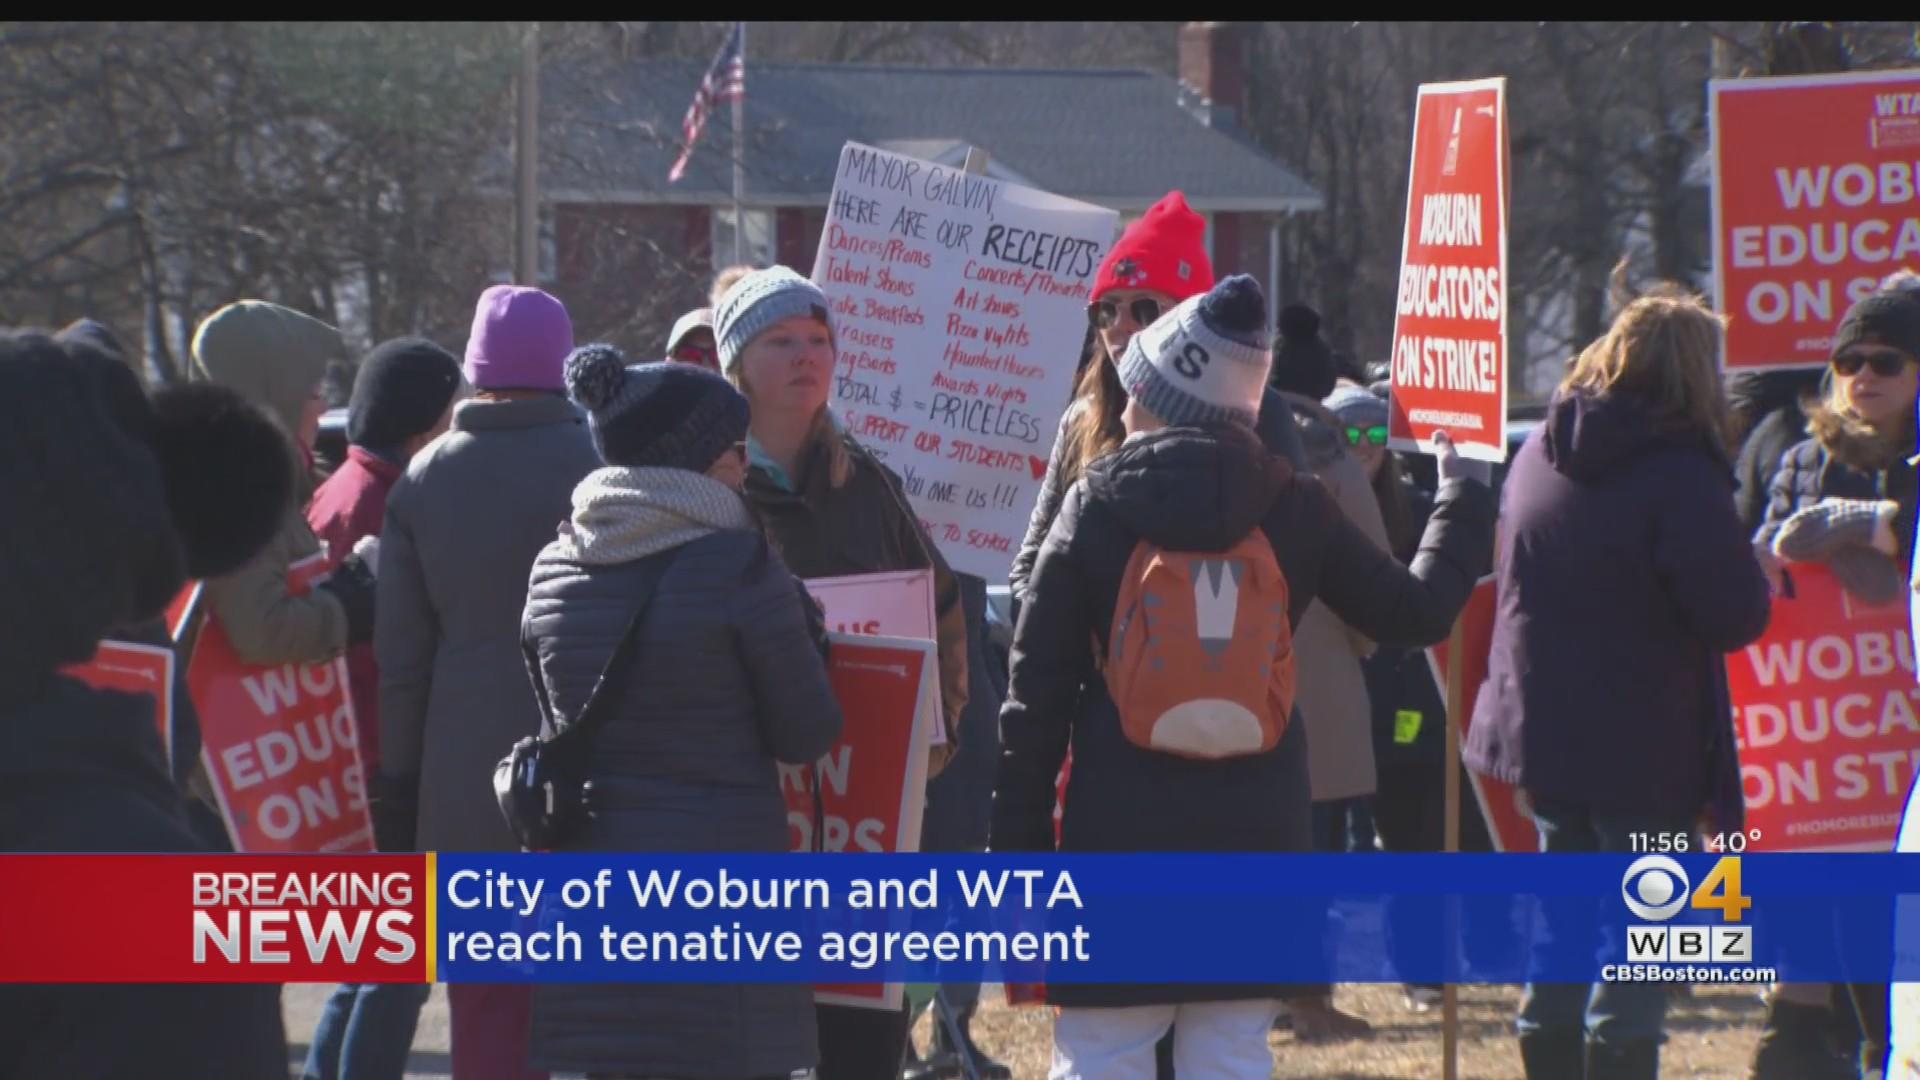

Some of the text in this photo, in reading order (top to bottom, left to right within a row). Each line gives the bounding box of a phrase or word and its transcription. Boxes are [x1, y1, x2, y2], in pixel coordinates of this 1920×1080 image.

[845, 148, 998, 221] MAYOR GALVIN,
[1775, 163, 1920, 209] WOB
[834, 190, 881, 225] HERE
[889, 205, 928, 240] ARE
[937, 219, 973, 254] OUR
[1419, 192, 1483, 247] WOBURN
[826, 256, 915, 297] Talent Shows
[1399, 264, 1500, 321] EDUCATORS
[1746, 279, 1833, 323] ON
[931, 370, 979, 396] Awards
[1174, 342, 1210, 379] S
[1396, 335, 1497, 393] ON STRIKE!
[835, 375, 880, 406] TOTAL
[929, 391, 1042, 443] PRICELESS
[845, 410, 911, 443] SUPPORT
[914, 430, 941, 457] OUR
[947, 439, 1025, 472] STUDENTS
[258, 777, 340, 840] ON
[1742, 760, 1821, 810] ON
